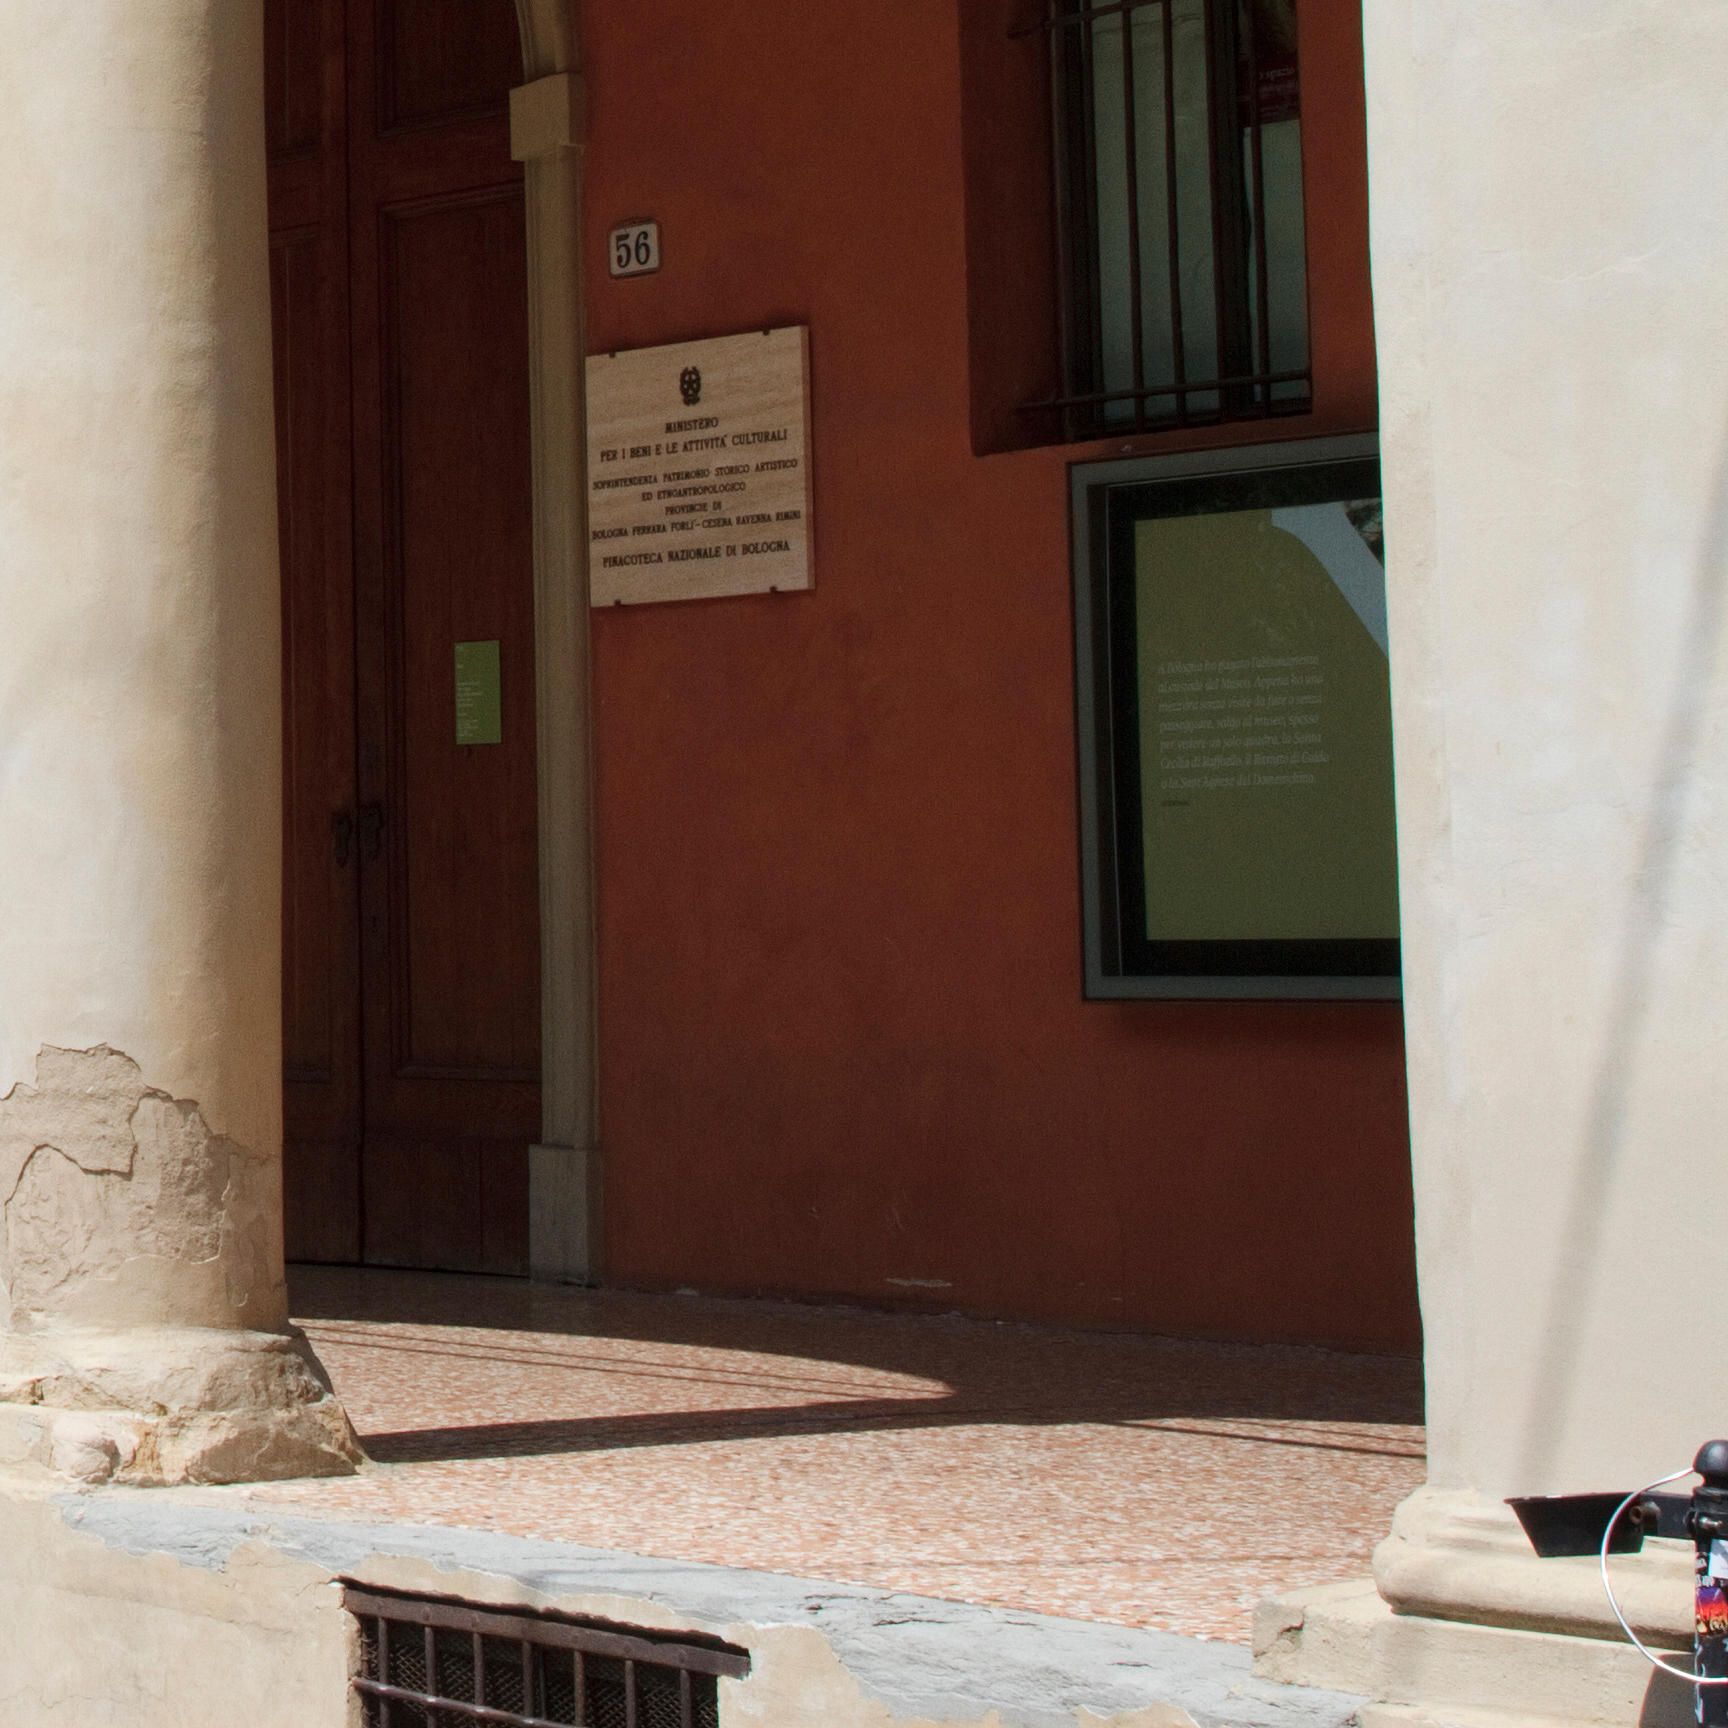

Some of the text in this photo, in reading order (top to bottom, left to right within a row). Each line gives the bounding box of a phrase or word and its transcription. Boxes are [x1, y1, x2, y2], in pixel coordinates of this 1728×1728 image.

[615, 231, 651, 269] 56
[665, 417, 718, 433] MINISTERO
[601, 449, 618, 462] PER
[622, 448, 625, 460] I
[630, 445, 651, 458] BENI
[656, 444, 661, 455] E
[666, 442, 678, 454] LE
[732, 429, 787, 445] CULTURALI
[663, 468, 710, 482] PATRIMONIO
[715, 464, 749, 476] STORICO
[755, 459, 798, 472] ARTISTICO
[642, 492, 653, 501] ED
[592, 529, 628, 540] BOLOGNA
[633, 525, 666, 536] FERRARA
[736, 514, 771, 525] RAVENNA
[776, 511, 800, 521] RIMINI
[603, 541, 790, 567] PINACOTECA NAZIONALE DI BOLOGNA
